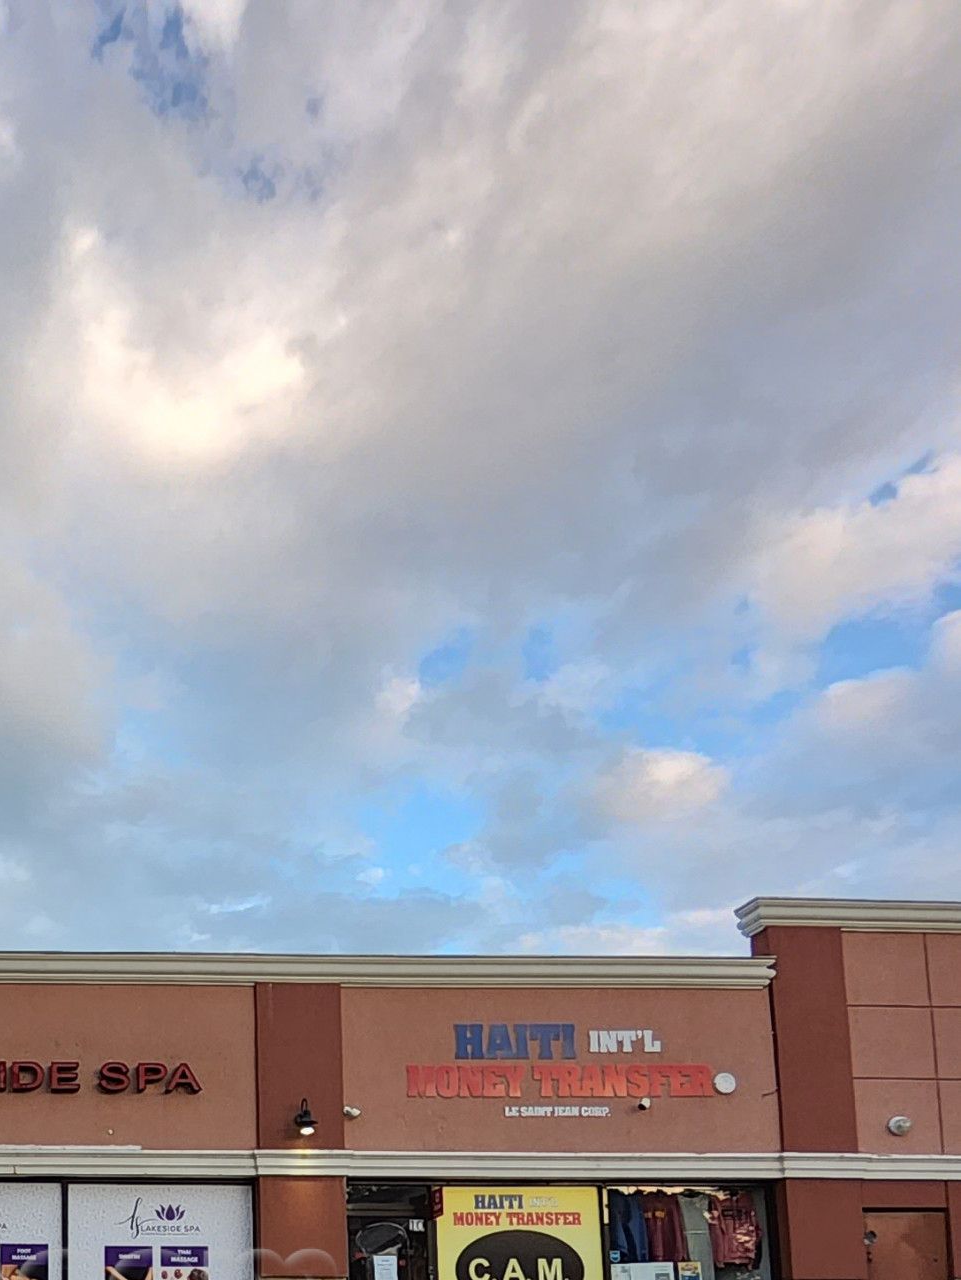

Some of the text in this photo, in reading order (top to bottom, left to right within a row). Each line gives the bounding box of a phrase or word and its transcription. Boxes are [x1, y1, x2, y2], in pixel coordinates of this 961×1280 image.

[453, 1023, 662, 1060] HAITI INT'L
[98, 1061, 202, 1095] SPA
[405, 1065, 715, 1098] MONEY TRANSFER
[504, 1106, 519, 1117] LE
[520, 1106, 553, 1117] SAINT
[554, 1106, 579, 1117] JEAN
[474, 1194, 523, 1210] HAITI
[453, 1212, 582, 1226] MONEY TRANSFER
[140, 1225, 181, 1233] LAKESIDE
